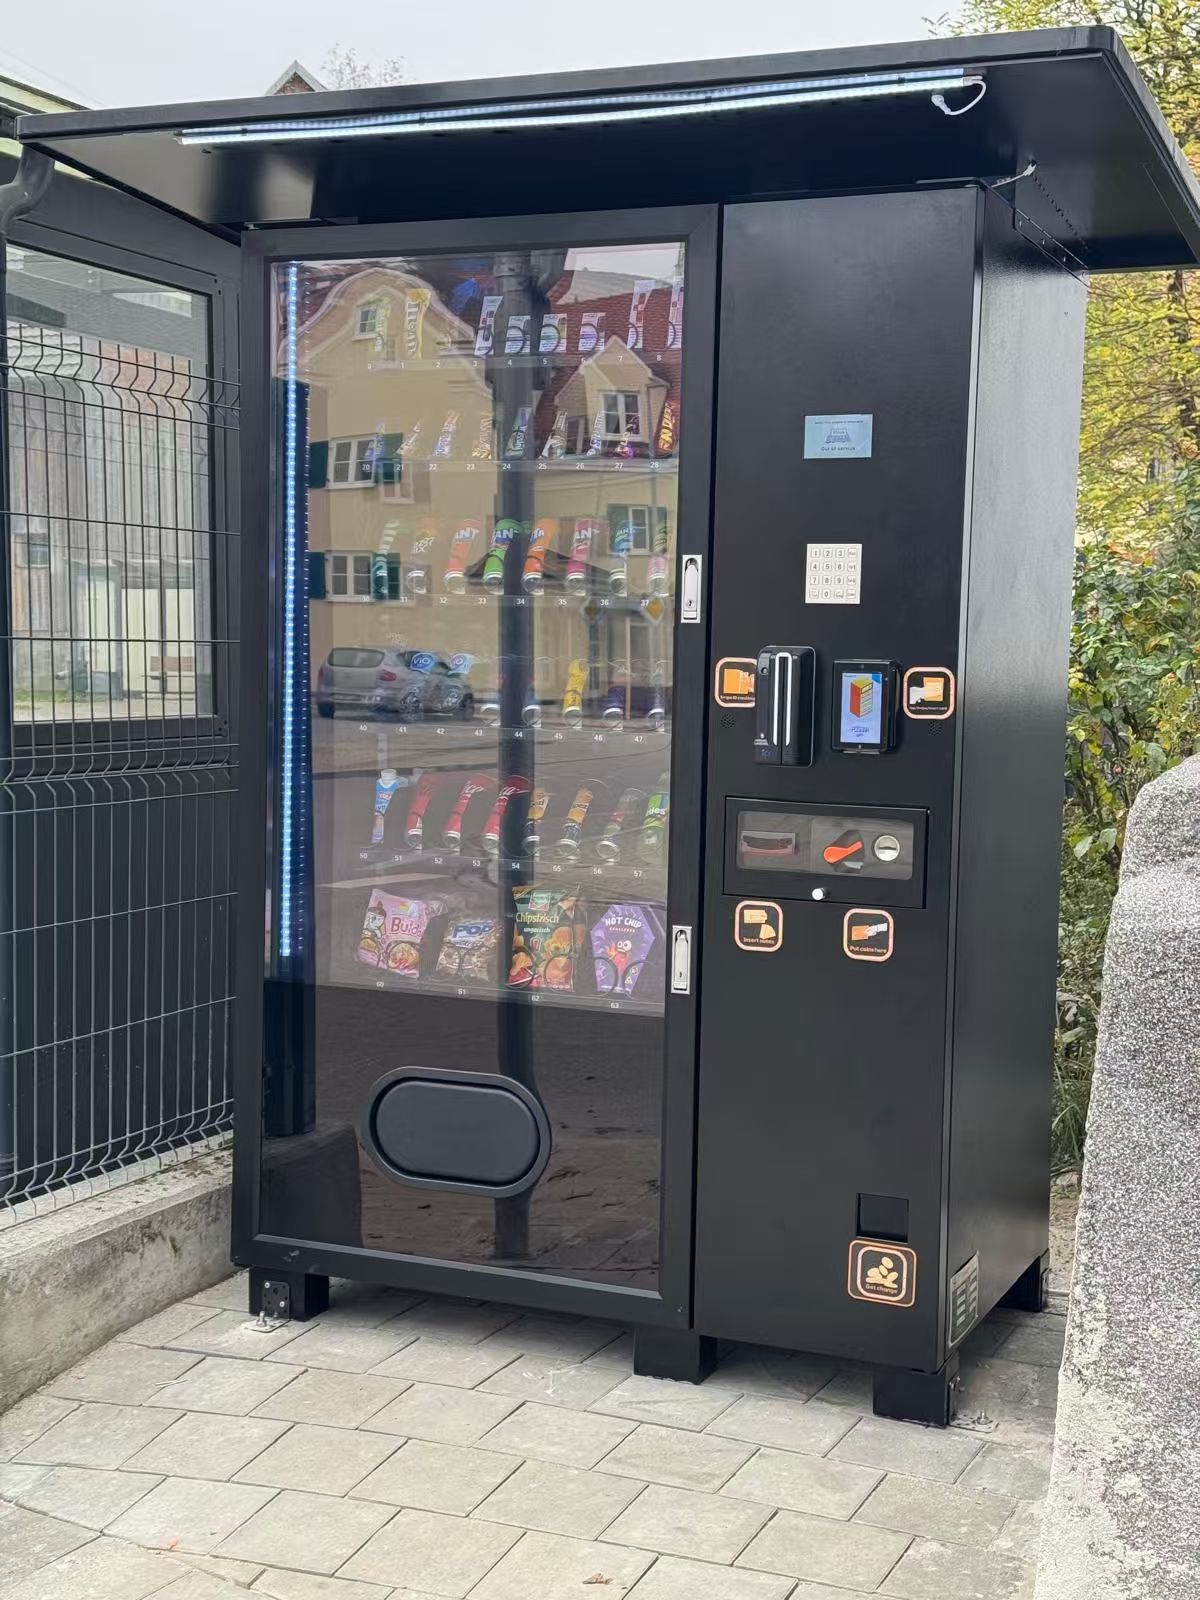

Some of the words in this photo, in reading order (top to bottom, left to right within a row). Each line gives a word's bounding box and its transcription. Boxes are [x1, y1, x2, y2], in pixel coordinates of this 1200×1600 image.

[516, 912, 559, 924] Chipsfrisch
[605, 917, 623, 926] HOT
[624, 918, 642, 928] CHIP
